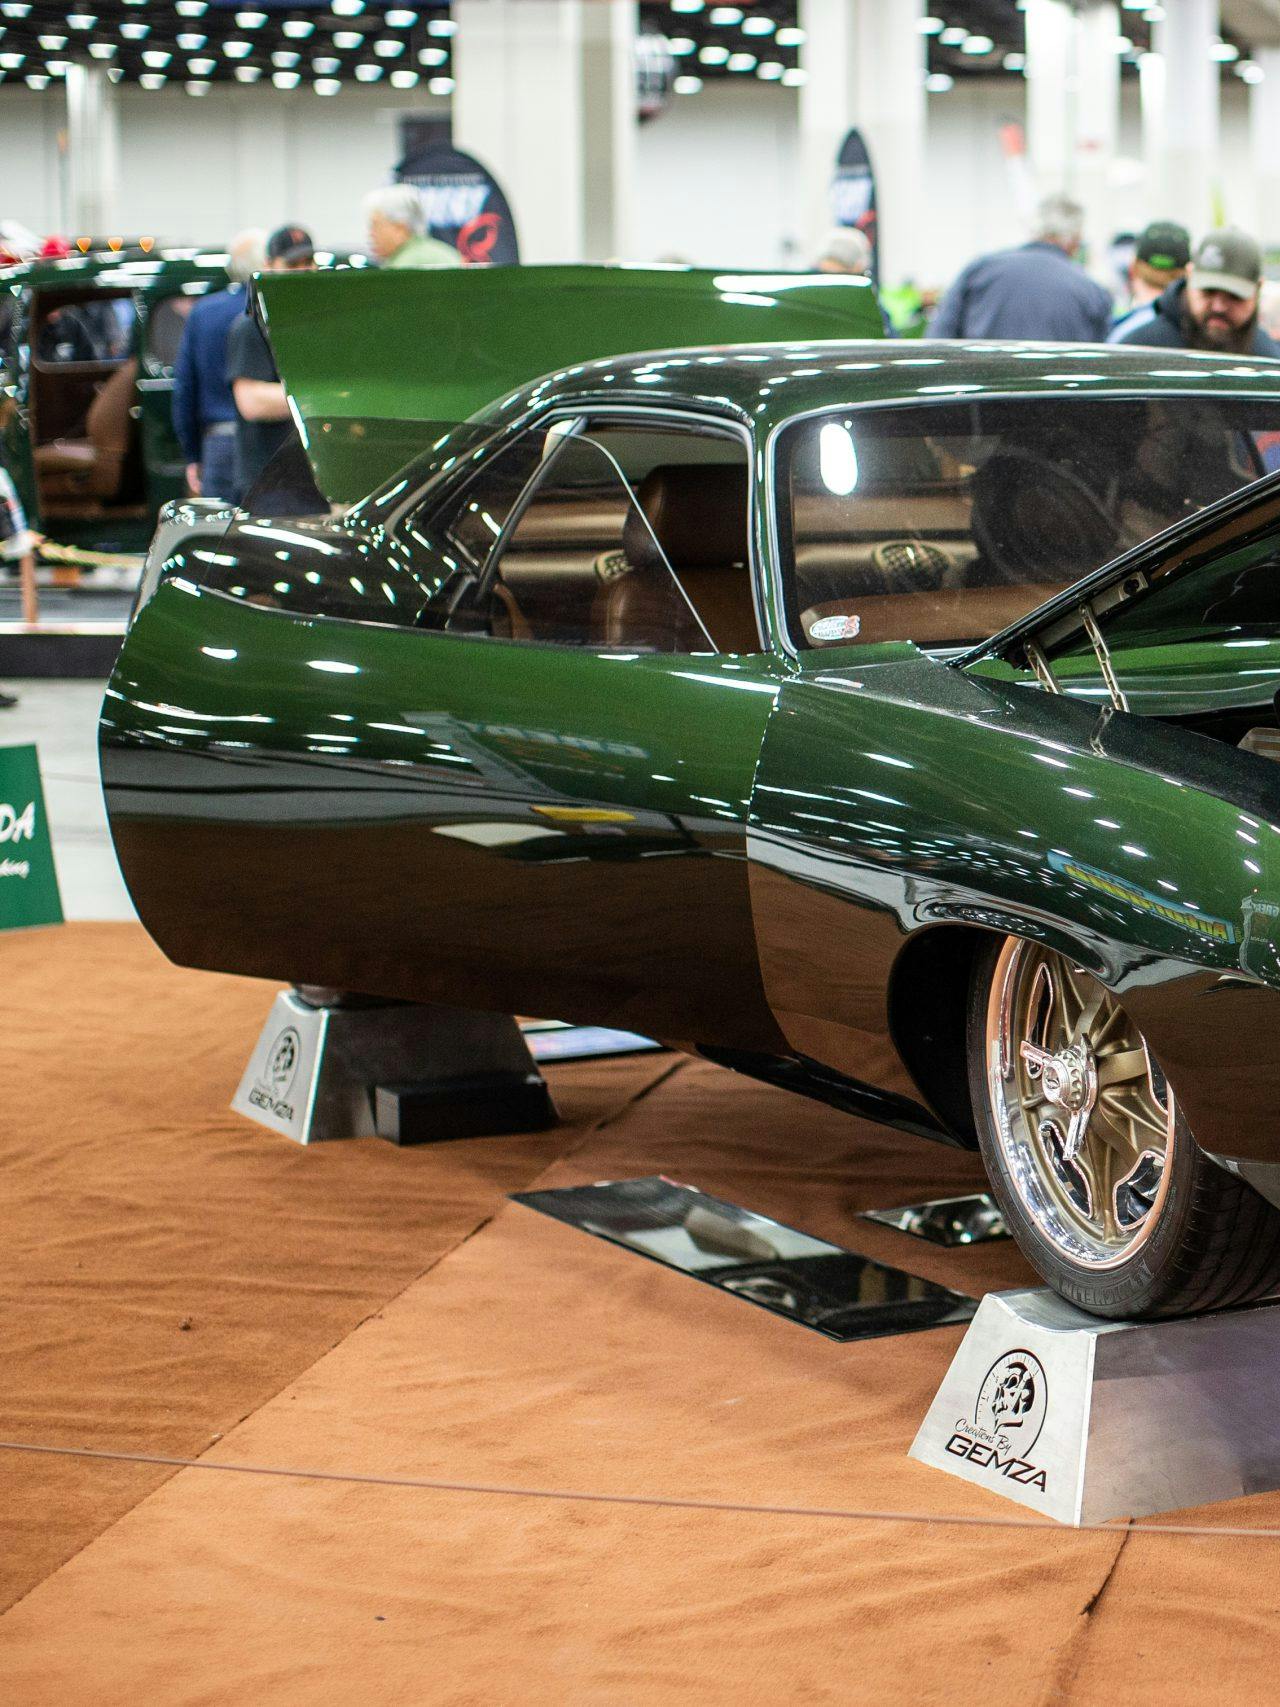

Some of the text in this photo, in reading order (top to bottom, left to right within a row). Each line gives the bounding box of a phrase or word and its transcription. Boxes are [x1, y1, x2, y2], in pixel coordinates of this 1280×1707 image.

[954, 1418, 1012, 1456] Creations By
[945, 1433, 1047, 1493] GEMZA
